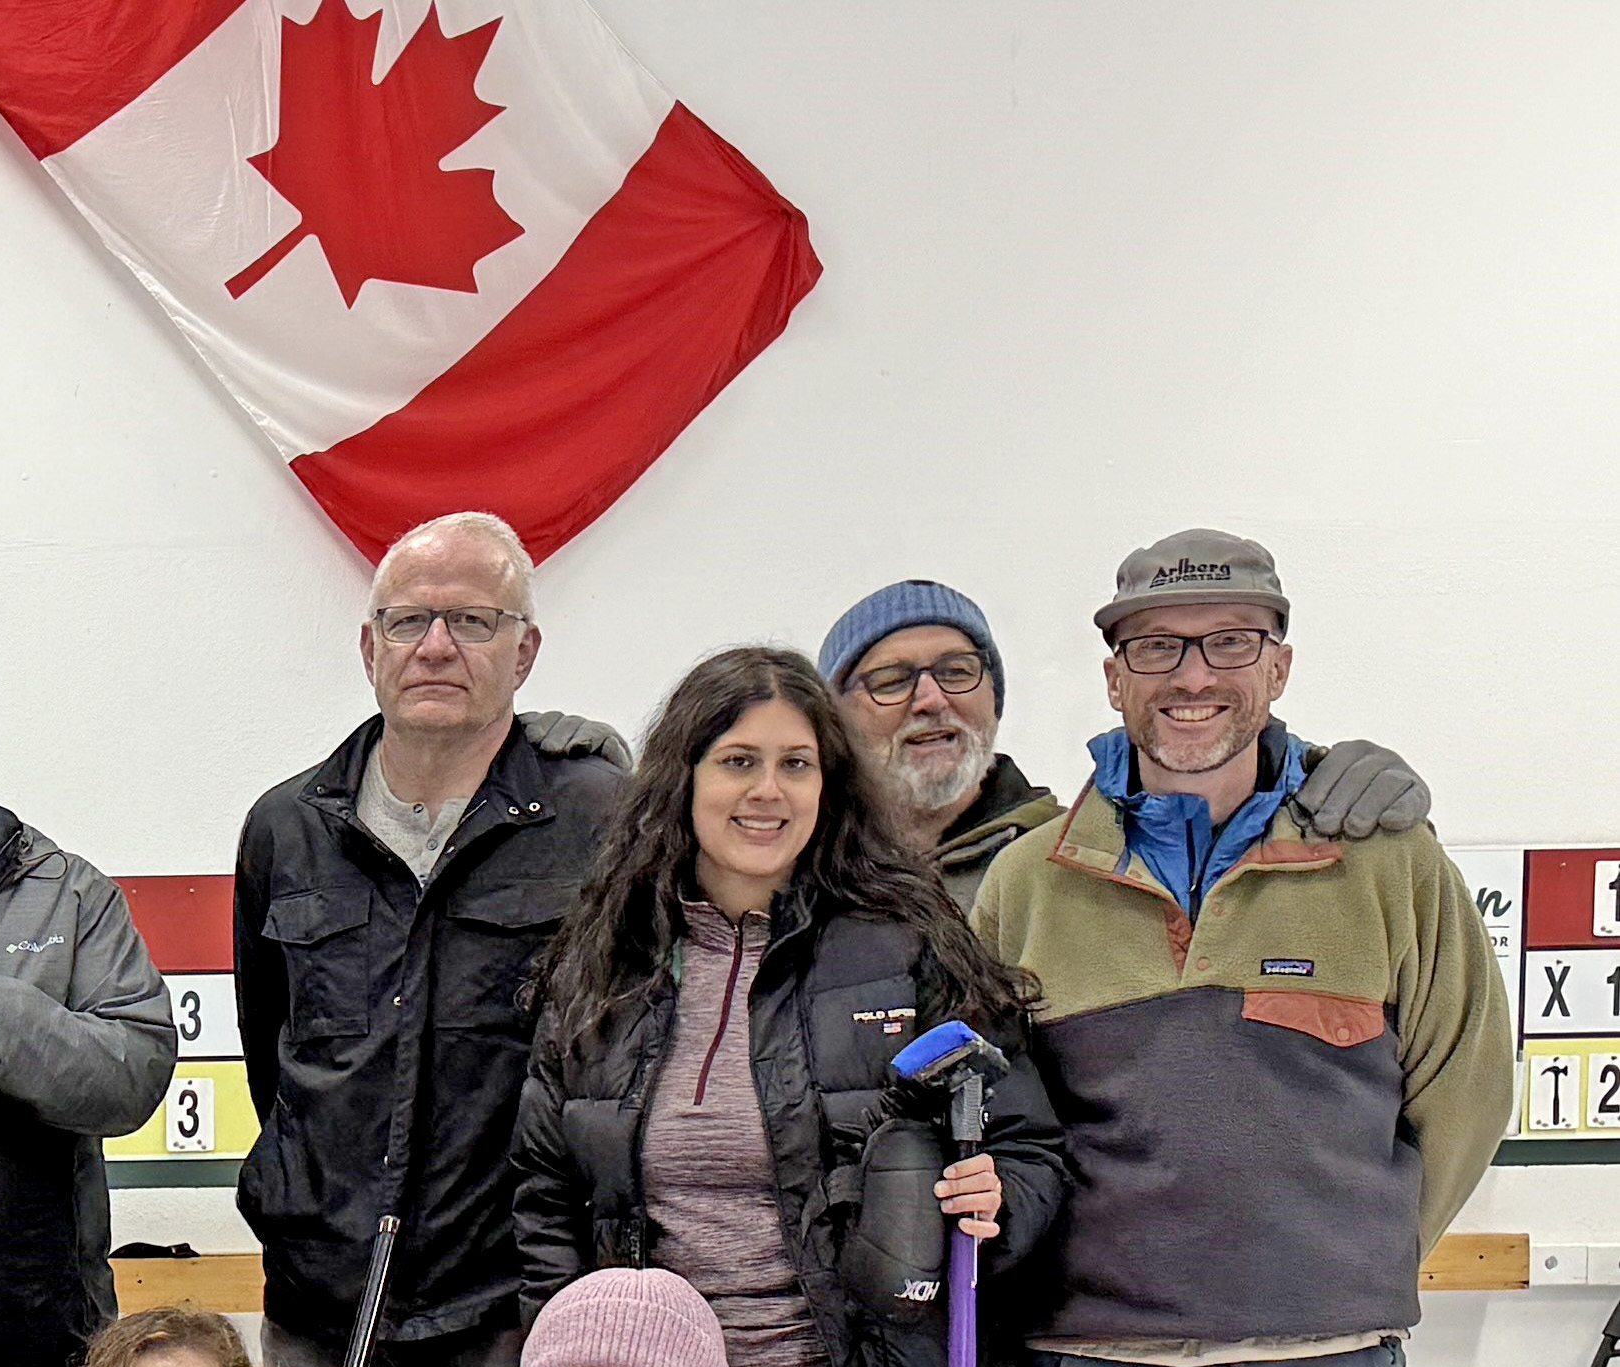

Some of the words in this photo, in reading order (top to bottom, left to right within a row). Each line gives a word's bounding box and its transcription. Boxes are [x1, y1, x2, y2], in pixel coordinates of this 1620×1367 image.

[1149, 557, 1231, 582] Arlberg
[179, 990, 202, 1042] 3
[1542, 966, 1571, 1017] X
[177, 1089, 200, 1138] 3
